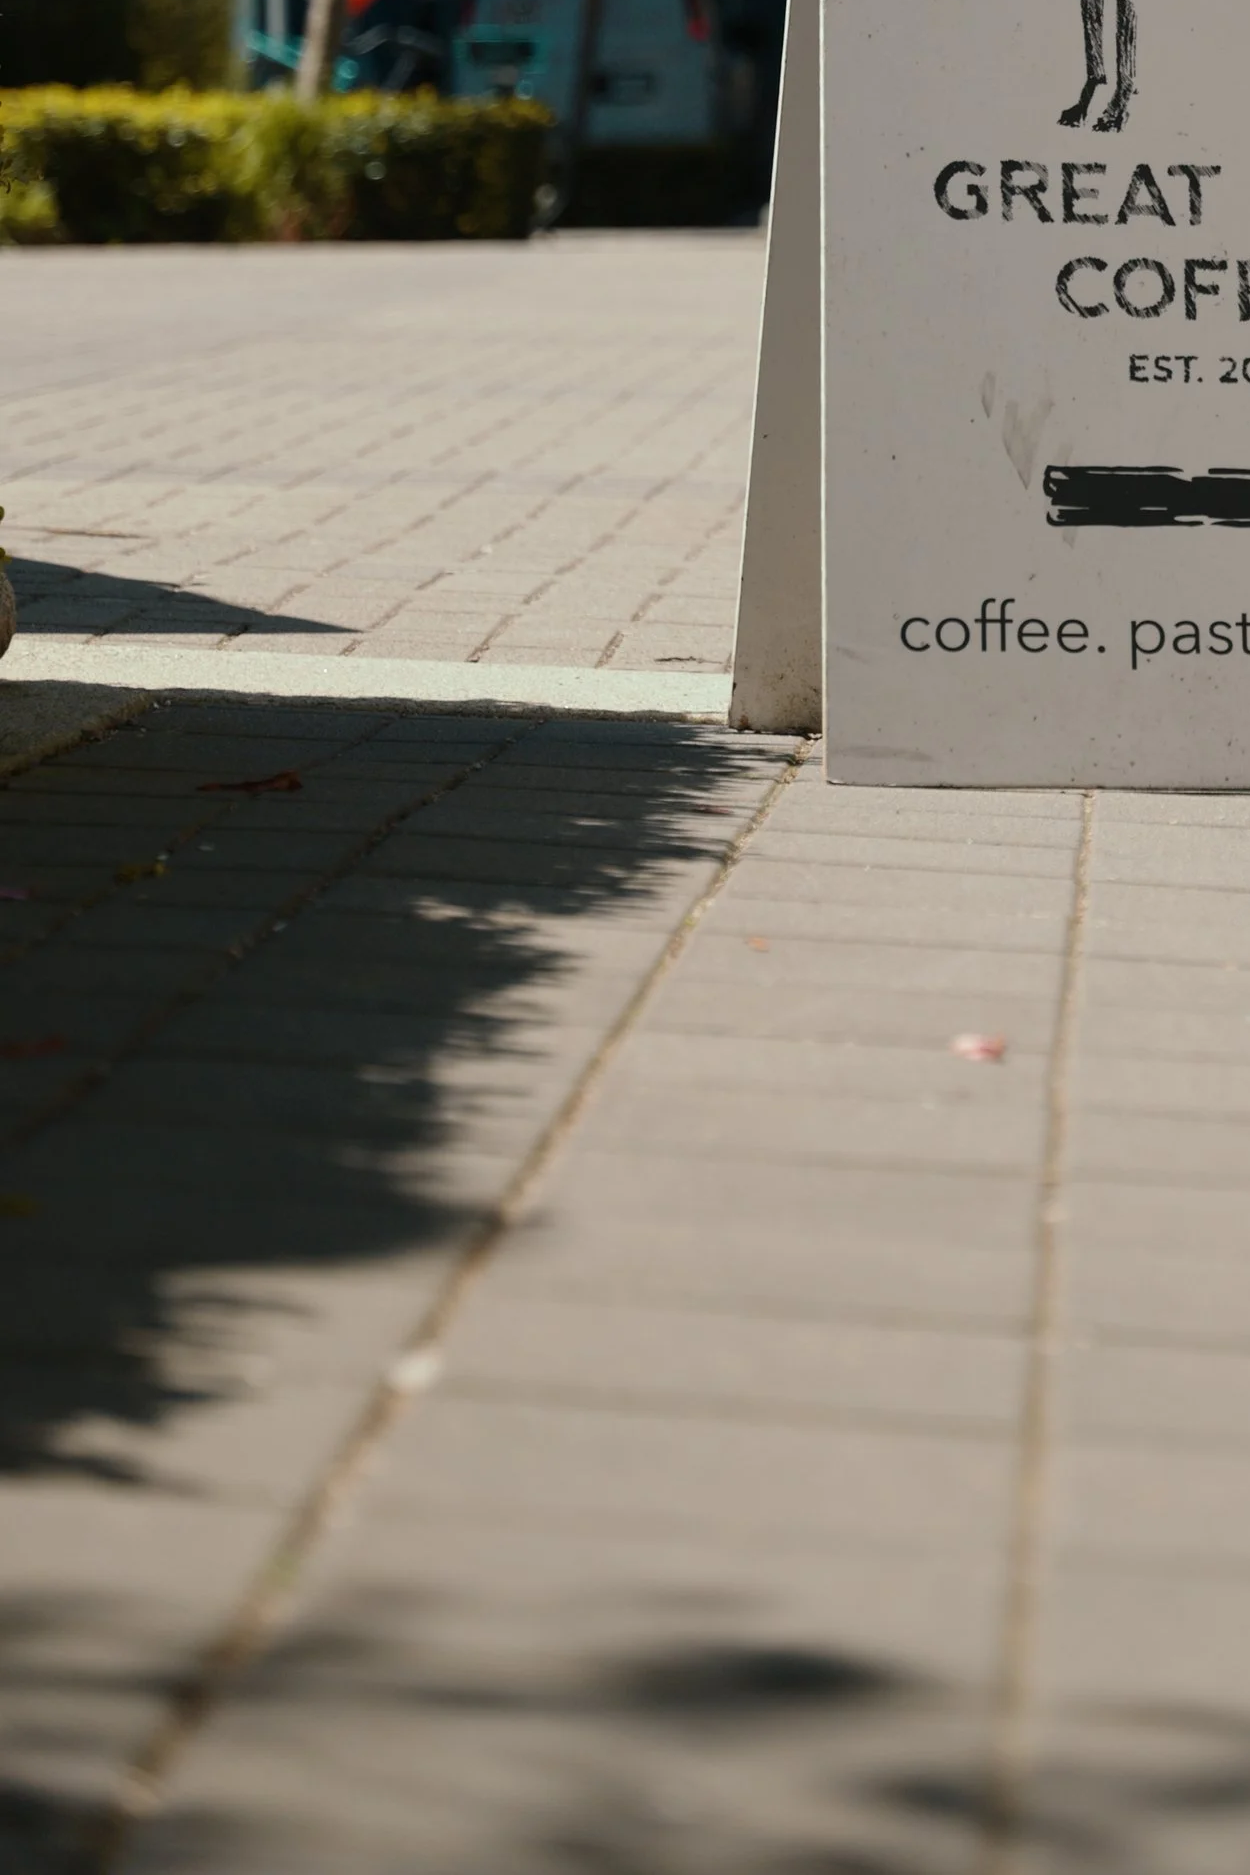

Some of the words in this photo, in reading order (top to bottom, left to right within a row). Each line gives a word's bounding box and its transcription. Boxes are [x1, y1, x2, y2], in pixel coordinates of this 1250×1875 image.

[933, 159, 1222, 227] GREAT
[1129, 354, 1203, 384] EST.
[900, 598, 1106, 654] coffee.
